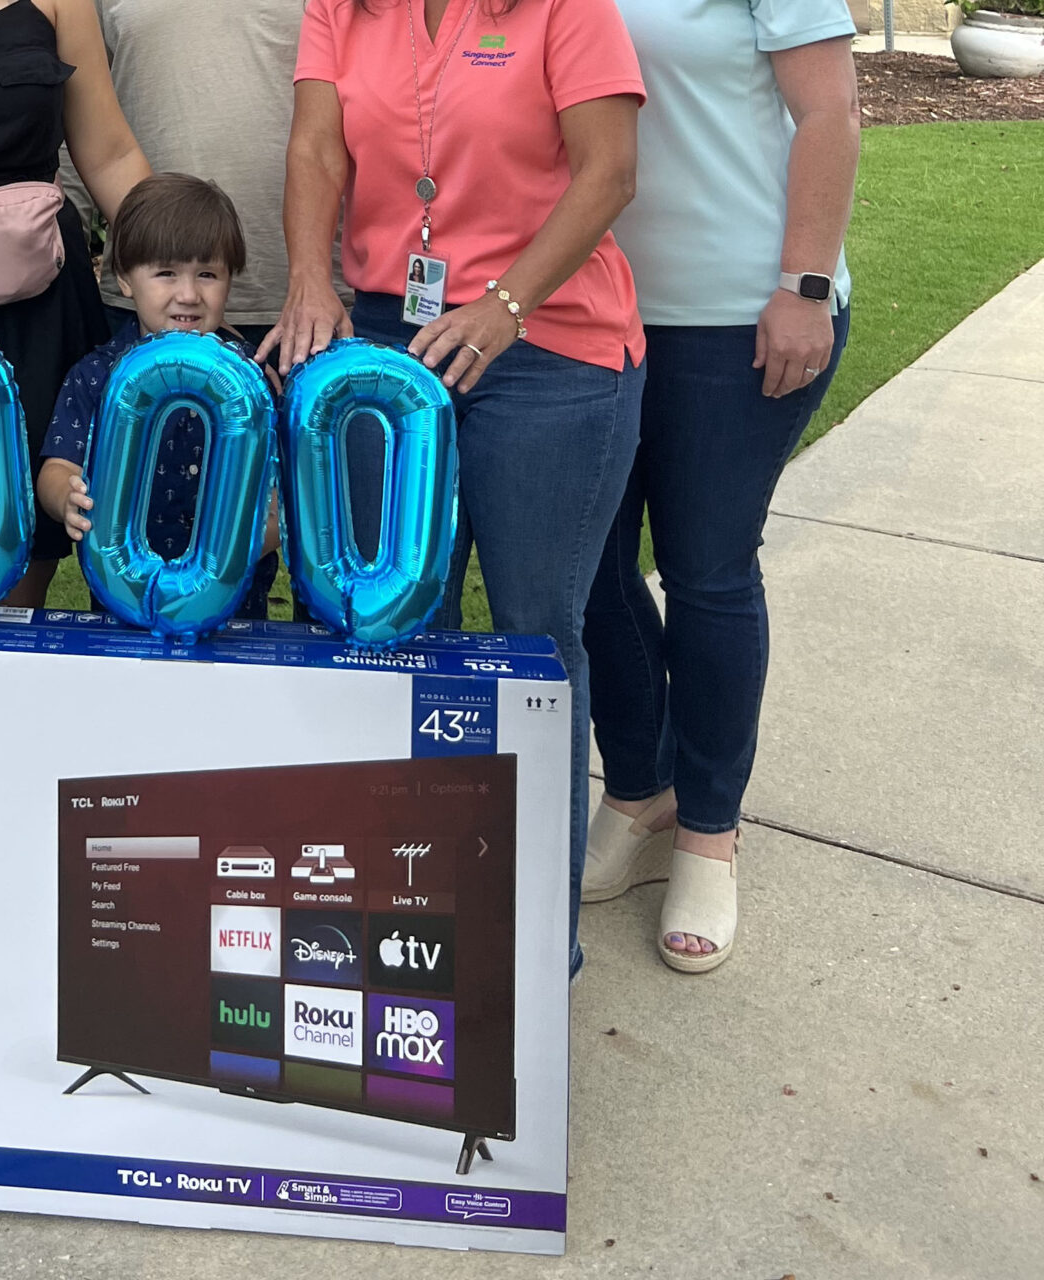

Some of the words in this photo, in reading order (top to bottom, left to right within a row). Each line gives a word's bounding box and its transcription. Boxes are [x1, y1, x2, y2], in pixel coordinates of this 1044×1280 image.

[462, 51, 495, 60] Singing
[496, 51, 516, 59] River
[333, 655, 426, 669] STUNNING
[464, 662, 513, 672] TCL
[464, 726, 492, 735] CLASS
[429, 782, 475, 795] Options
[71, 798, 94, 808] TCL
[126, 795, 139, 807] TV
[92, 843, 112, 852] Home
[92, 862, 122, 871] Featured
[124, 863, 140, 872] Free
[92, 882, 102, 891] My
[103, 882, 121, 891] Feed
[226, 889, 248, 900] Cable
[249, 891, 266, 900] box
[293, 891, 317, 901] Game
[319, 893, 353, 903] console
[92, 900, 115, 910] Search
[392, 895, 412, 906] Live
[415, 897, 428, 907] TV
[92, 919, 126, 930] Streaming
[128, 921, 160, 932] Channels
[92, 938, 120, 949] Settings
[219, 929, 272, 951] NETFLIX
[406, 935, 442, 970] tv
[219, 1000, 271, 1028] hulu
[384, 1006, 439, 1037] HBO
[293, 1024, 354, 1047] Channel
[376, 1032, 444, 1065] max
[117, 1169, 162, 1187] TCL
[226, 1177, 252, 1195] TV
[291, 1182, 322, 1194] Smart
[322, 1185, 330, 1194] &
[304, 1191, 338, 1204] Simple
[451, 1198, 465, 1207] Easy
[466, 1199, 483, 1207] Voice
